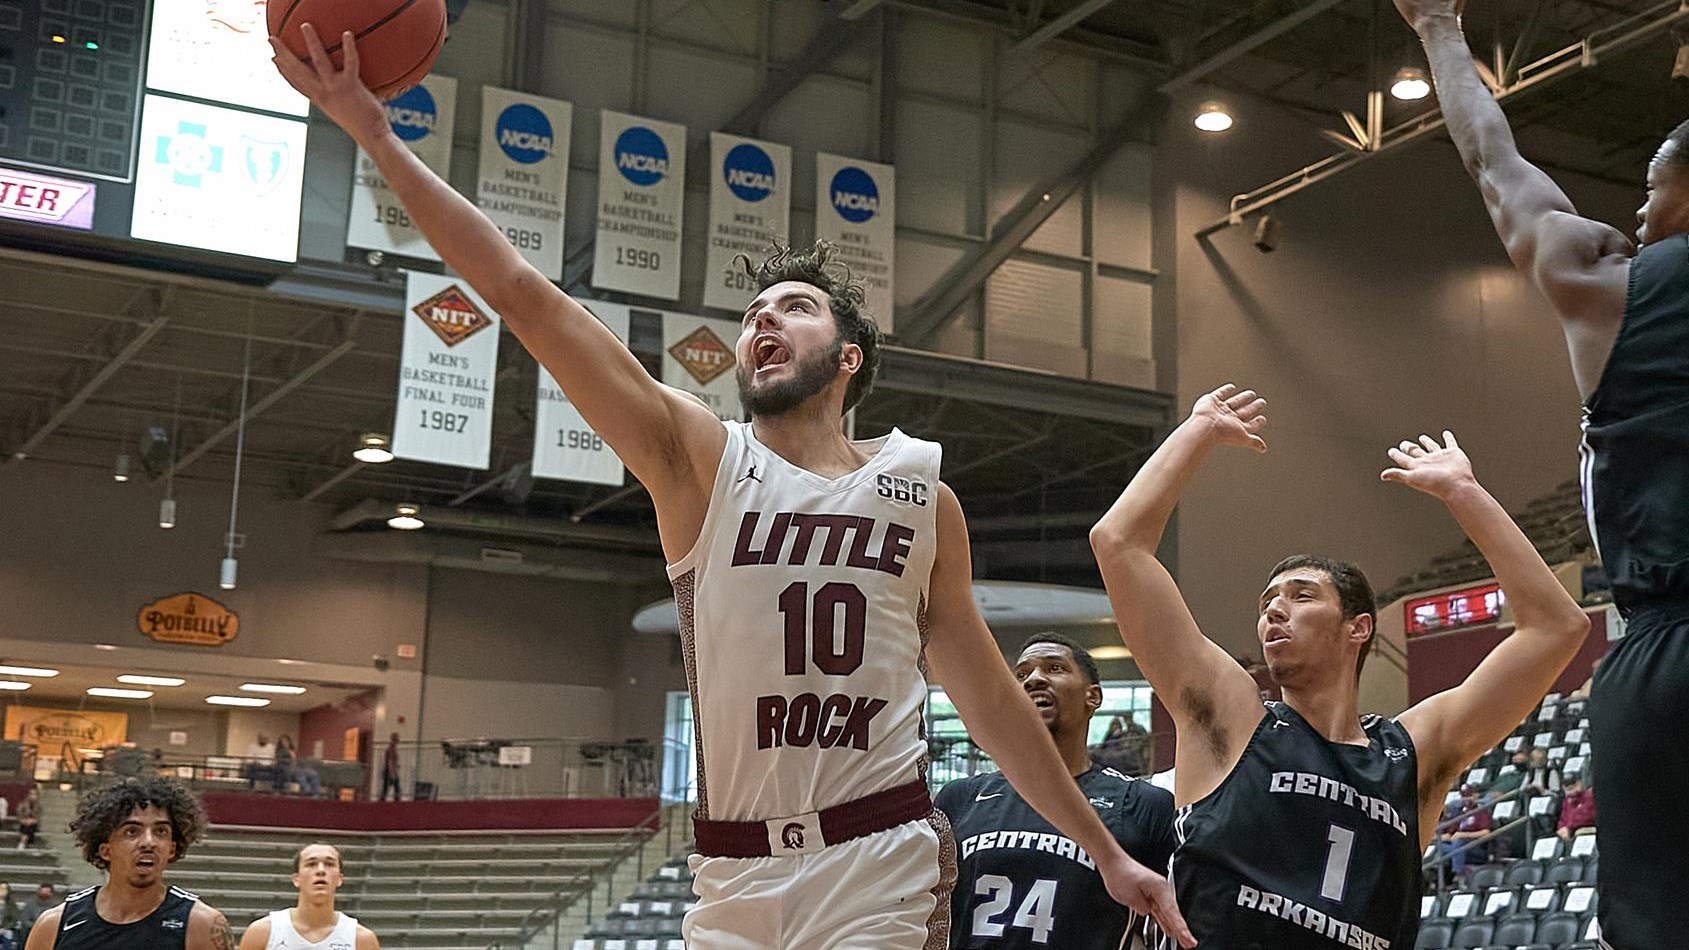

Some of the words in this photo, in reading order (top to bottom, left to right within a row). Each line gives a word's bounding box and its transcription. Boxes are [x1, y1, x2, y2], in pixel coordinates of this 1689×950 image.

[501, 129, 551, 151] NCAA
[619, 152, 667, 173] NCAA
[504, 169, 540, 185] MEN'S
[728, 168, 775, 191] NCAA
[483, 181, 558, 206] BASKETBALL
[834, 190, 879, 212] NCAA
[374, 204, 418, 231] 198
[478, 197, 562, 222] CHAMPIONSHIP
[603, 203, 677, 227] BASKETBALL
[497, 226, 543, 251] 989
[598, 218, 679, 242] CHAMPIONSHIP
[616, 247, 660, 271] 1990
[431, 306, 477, 327] NIT
[428, 352, 470, 370] MEN'S
[685, 347, 727, 365] NIT
[403, 367, 489, 392] BASKETBALL
[404, 386, 446, 404] FINAL
[451, 392, 486, 410] FOUR
[419, 409, 469, 433] 1987
[876, 472, 928, 508] SBC
[731, 511, 915, 578] LITTLE
[778, 581, 867, 677] 10
[756, 692, 889, 752] ROCK
[1320, 823, 1355, 902] 1
[972, 873, 1058, 944] 24
[1236, 884, 1391, 950] ARKANSAS
